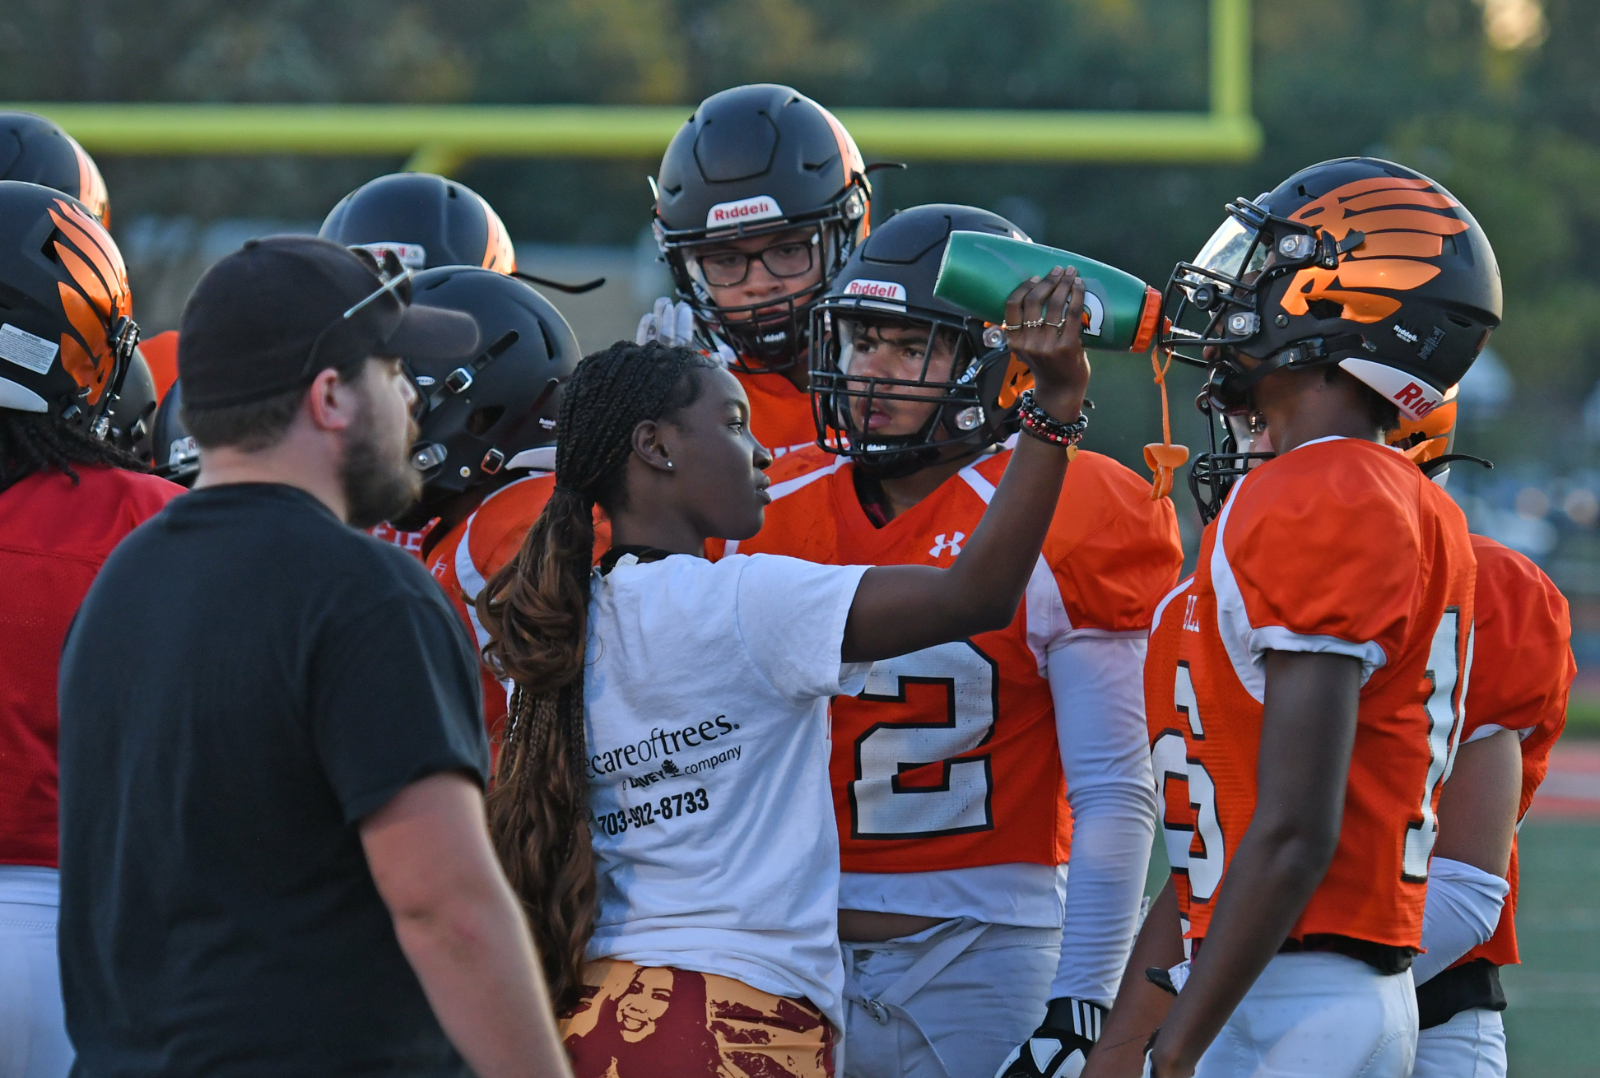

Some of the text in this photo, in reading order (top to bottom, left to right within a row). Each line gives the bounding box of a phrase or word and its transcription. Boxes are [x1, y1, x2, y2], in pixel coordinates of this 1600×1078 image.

[714, 202, 770, 221] Riddell
[850, 282, 897, 298] Riddell
[847, 638, 999, 841] 2
[684, 744, 742, 775] company
[597, 787, 710, 836] 703-922-8733
